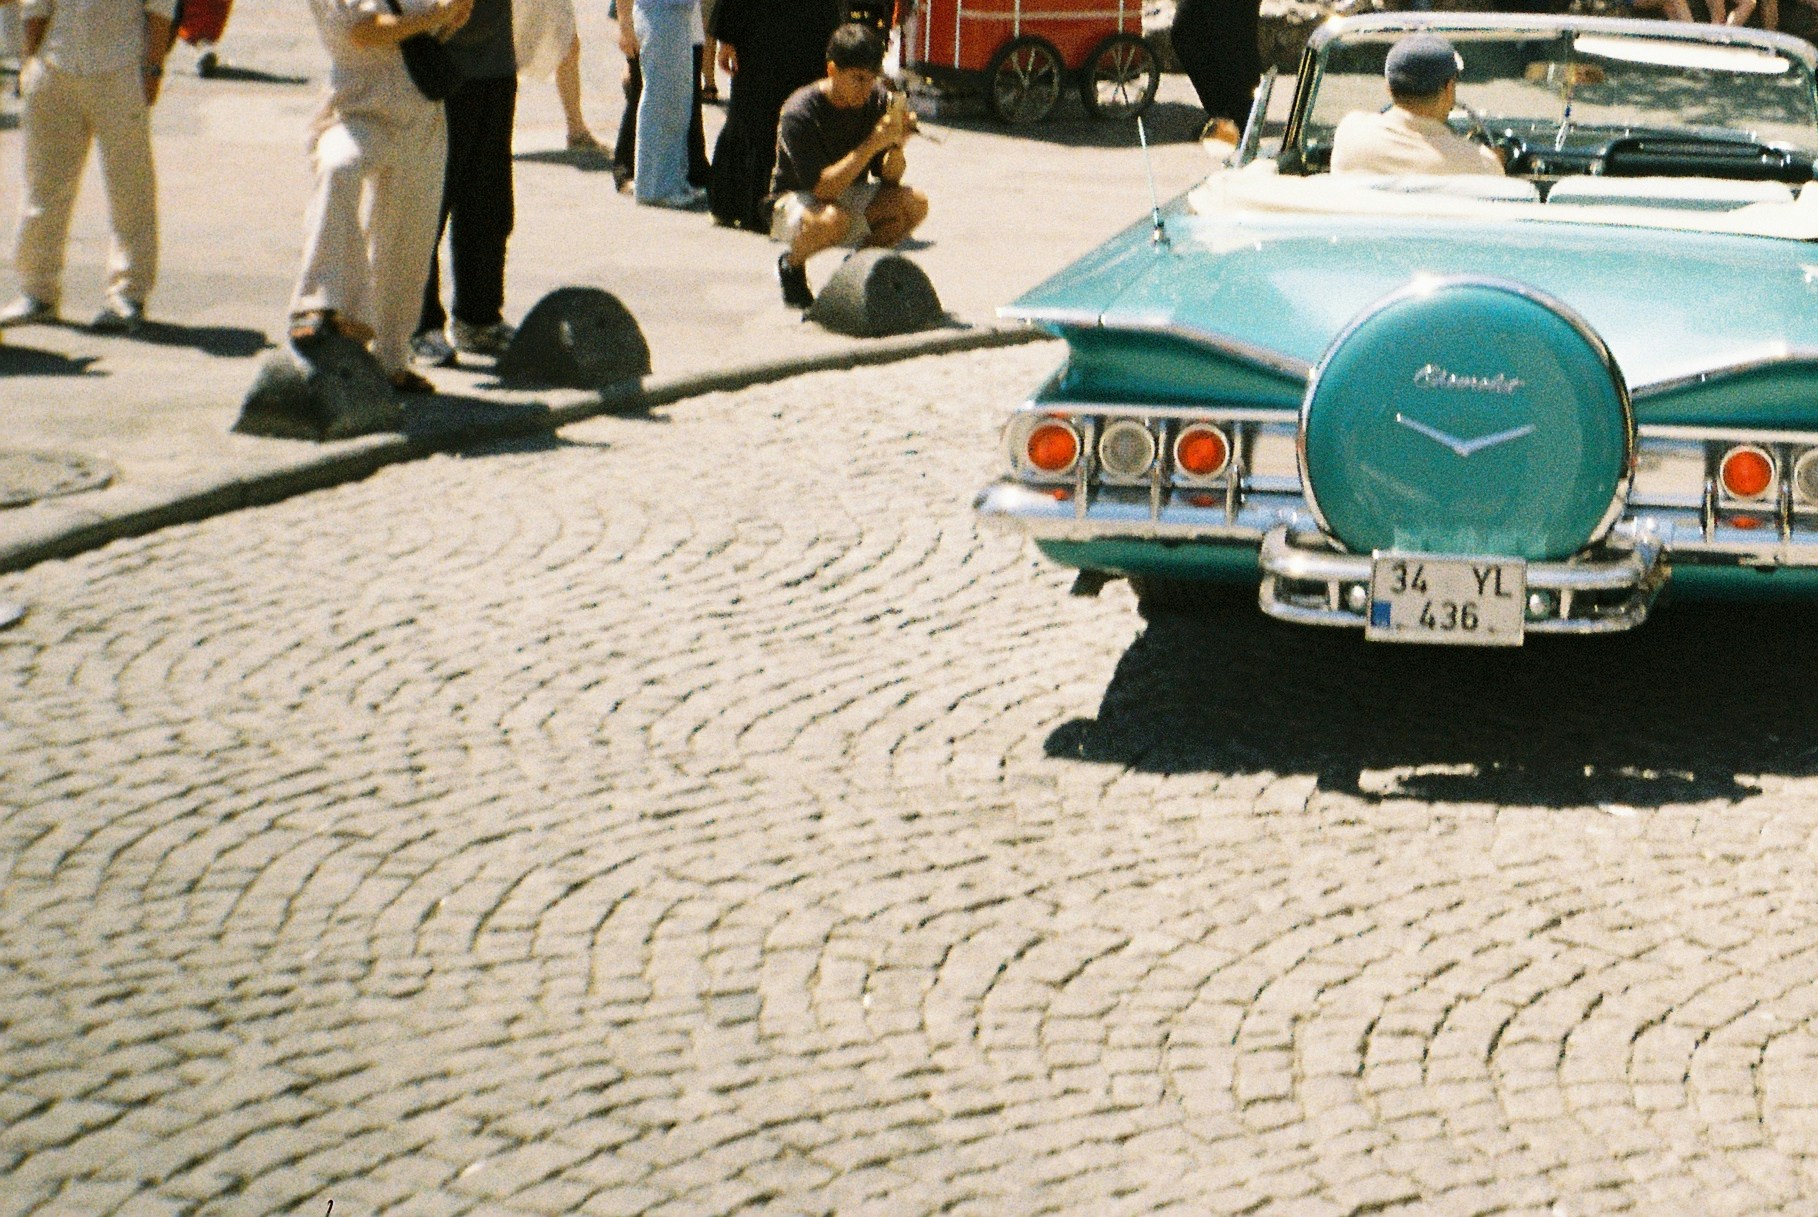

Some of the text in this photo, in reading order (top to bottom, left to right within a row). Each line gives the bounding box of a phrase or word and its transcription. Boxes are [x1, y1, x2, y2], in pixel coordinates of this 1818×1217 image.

[1390, 560, 1512, 597] 34 YL
[1418, 600, 1479, 631] 436
